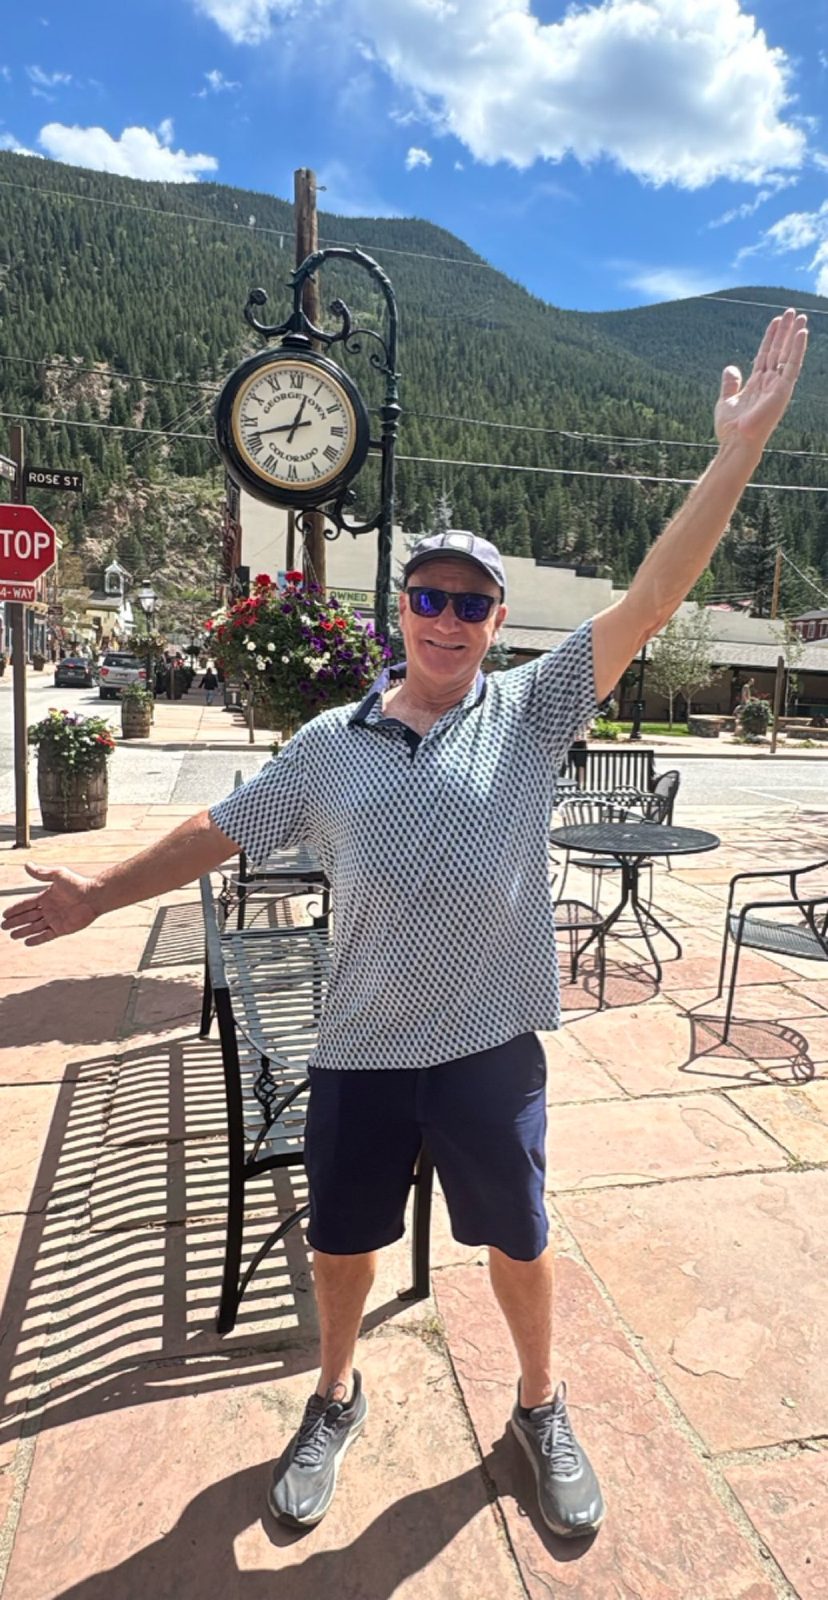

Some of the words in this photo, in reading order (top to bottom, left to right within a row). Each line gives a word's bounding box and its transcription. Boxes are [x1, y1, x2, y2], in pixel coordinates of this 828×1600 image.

[264, 376, 281, 393] XI
[289, 374, 304, 390] XII
[263, 391, 327, 420] GEORGETOWN
[241, 414, 258, 427] IX
[330, 426, 344, 438] III
[269, 442, 318, 462] COLORADO
[28, 472, 60, 486] ROSE
[63, 476, 82, 487] ST.
[0, 530, 50, 560] TOP
[0, 586, 33, 600] 4-WAY
[330, 591, 367, 602] OWNED
